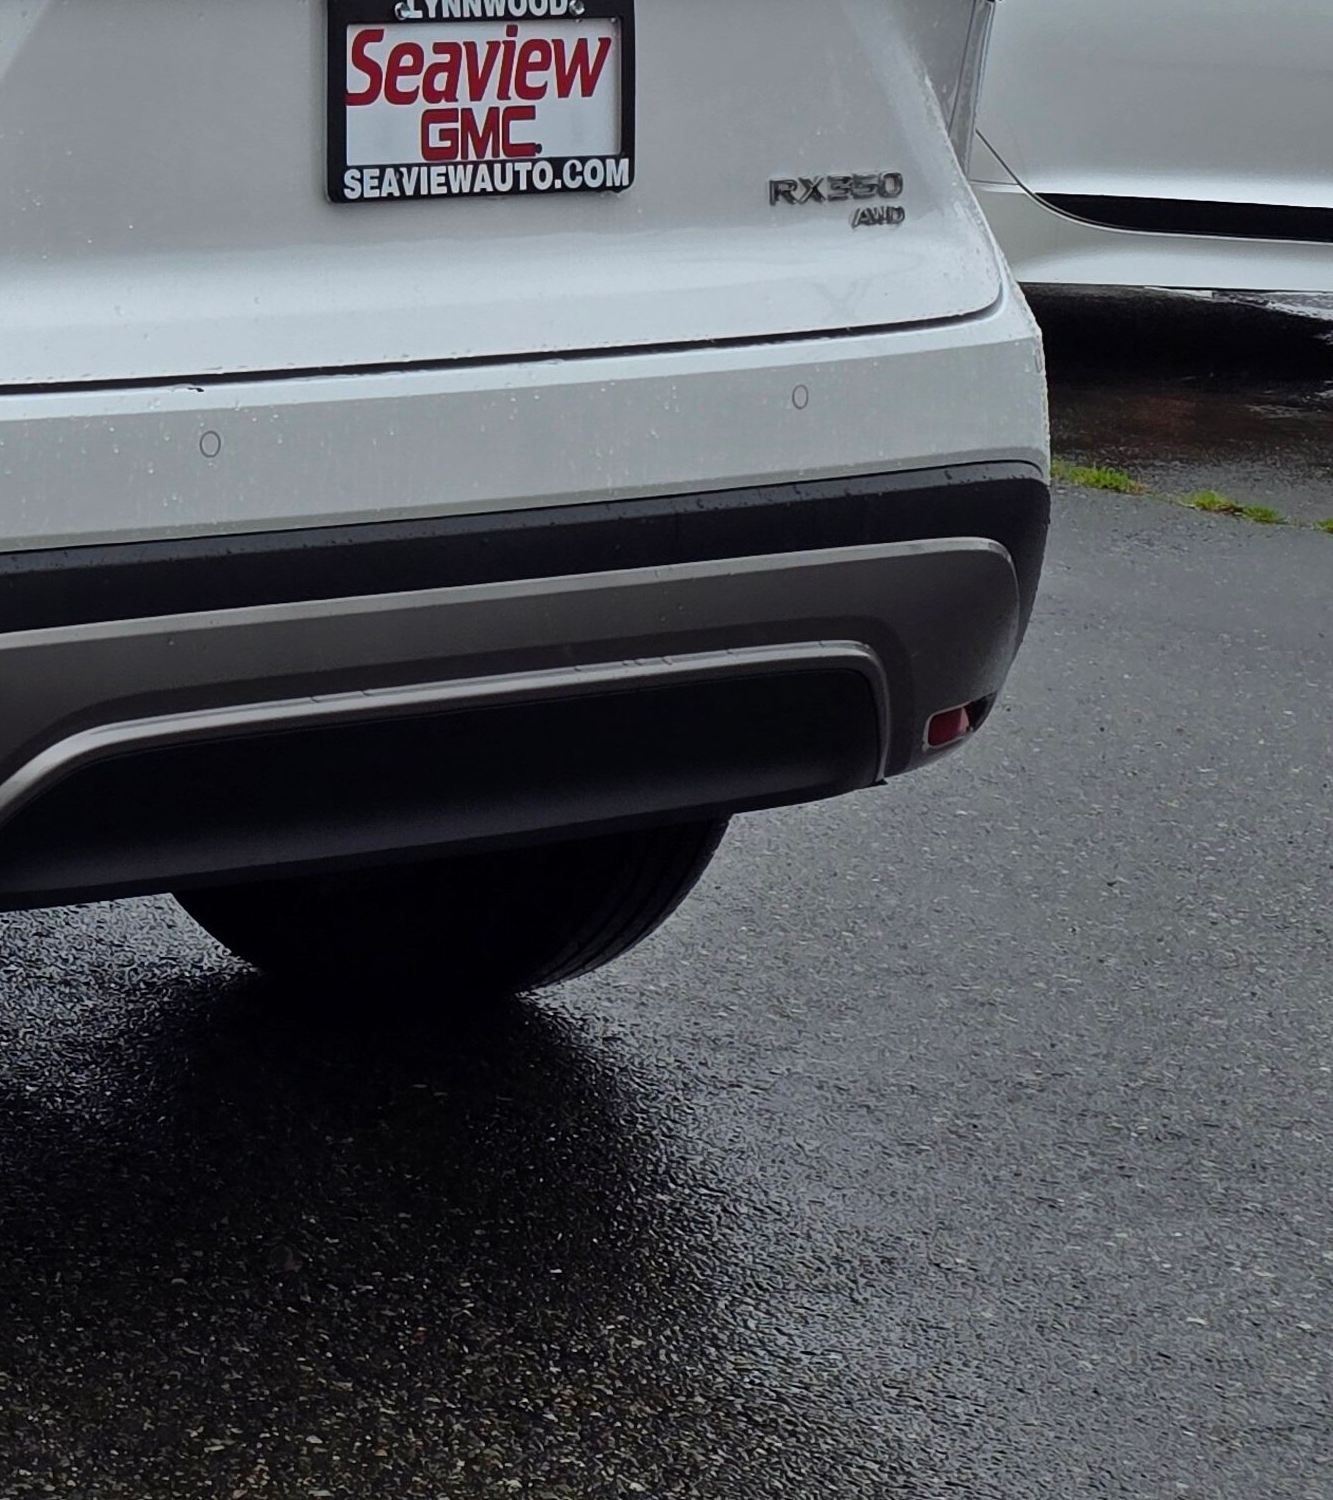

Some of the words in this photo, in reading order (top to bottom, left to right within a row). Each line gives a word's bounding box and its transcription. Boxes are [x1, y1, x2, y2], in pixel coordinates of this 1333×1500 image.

[345, 24, 612, 106] Seaview
[420, 105, 537, 161] GMC
[343, 158, 630, 200] SEAVIEWAUTO.COM
[850, 205, 906, 228] AWD
